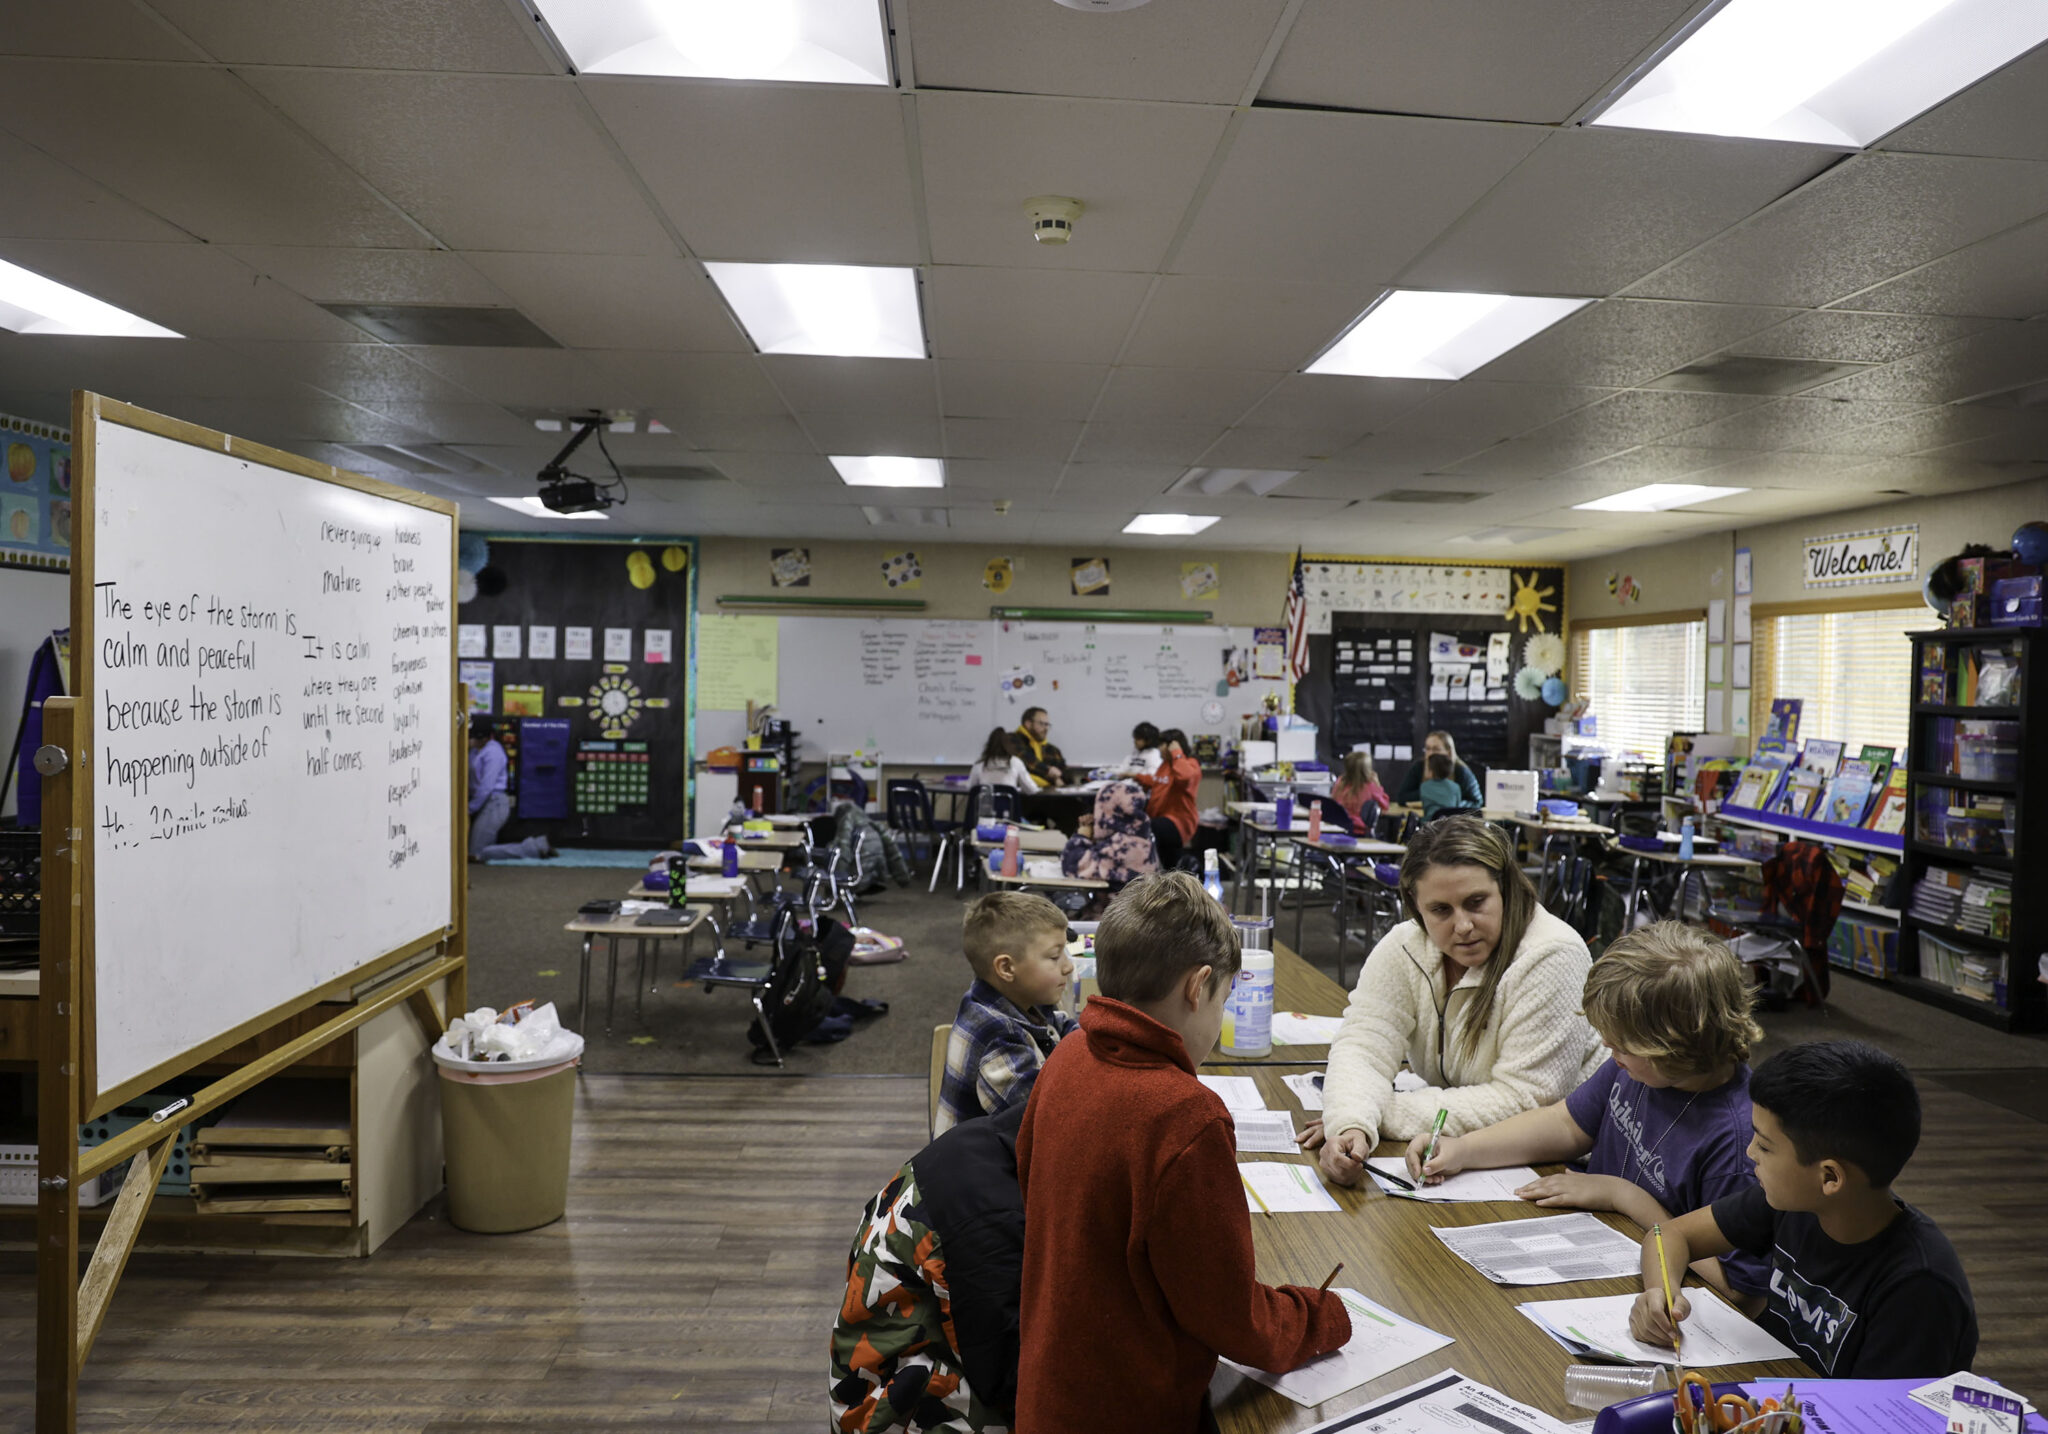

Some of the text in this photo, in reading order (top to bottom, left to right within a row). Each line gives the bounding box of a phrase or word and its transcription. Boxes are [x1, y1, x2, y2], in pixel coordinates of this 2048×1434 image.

[392, 553, 415, 573] brave
[1809, 536, 1911, 577] Welcome!
[95, 582, 133, 619] The
[144, 601, 171, 627] eye
[179, 593, 199, 622] of
[207, 595, 235, 625] the
[286, 609, 297, 636] is
[104, 631, 255, 678] calm and peaceful
[302, 632, 370, 660] It is calm
[303, 674, 377, 701] where they are
[106, 689, 183, 731] because
[190, 685, 217, 722] the
[269, 688, 281, 716] is
[303, 704, 328, 730] until
[336, 703, 352, 725] the
[393, 704, 420, 735] loyalty
[107, 726, 271, 798] happening outside of
[307, 747, 329, 776] half
[1476, 1391, 1509, 1408] Addition
[1510, 1406, 1537, 1420] Riddle
